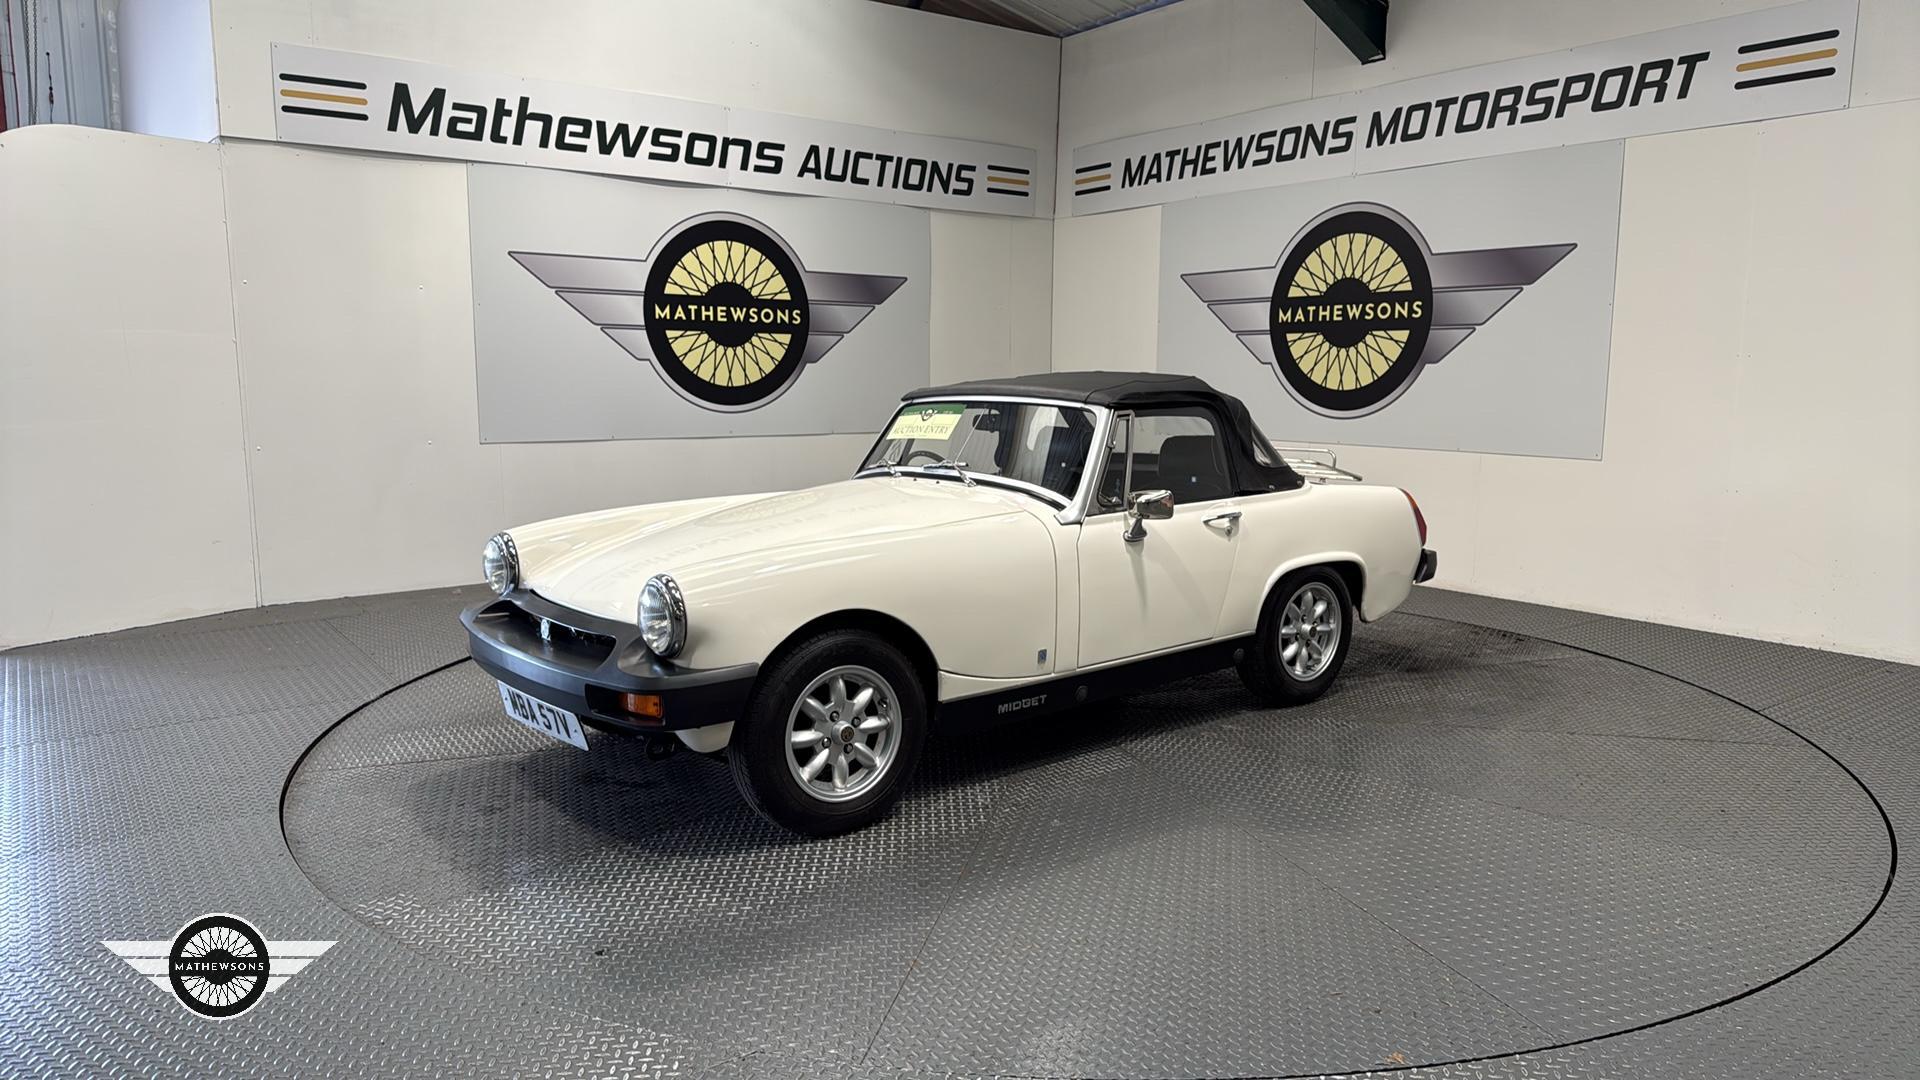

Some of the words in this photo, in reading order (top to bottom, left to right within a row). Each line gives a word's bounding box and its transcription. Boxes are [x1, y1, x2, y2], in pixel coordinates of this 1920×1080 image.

[1121, 116, 1357, 189] MATHEWSONS
[1366, 51, 1711, 149] MOTORSPORT
[387, 82, 785, 174] Mathewsons
[797, 144, 976, 196] AUCTIONS
[654, 303, 801, 325] MATHEWSONS
[1278, 301, 1423, 323] MATHEWSONS
[923, 425, 950, 434] ENTRY
[997, 694, 1048, 714] MIDGET
[537, 703, 572, 739] 57V
